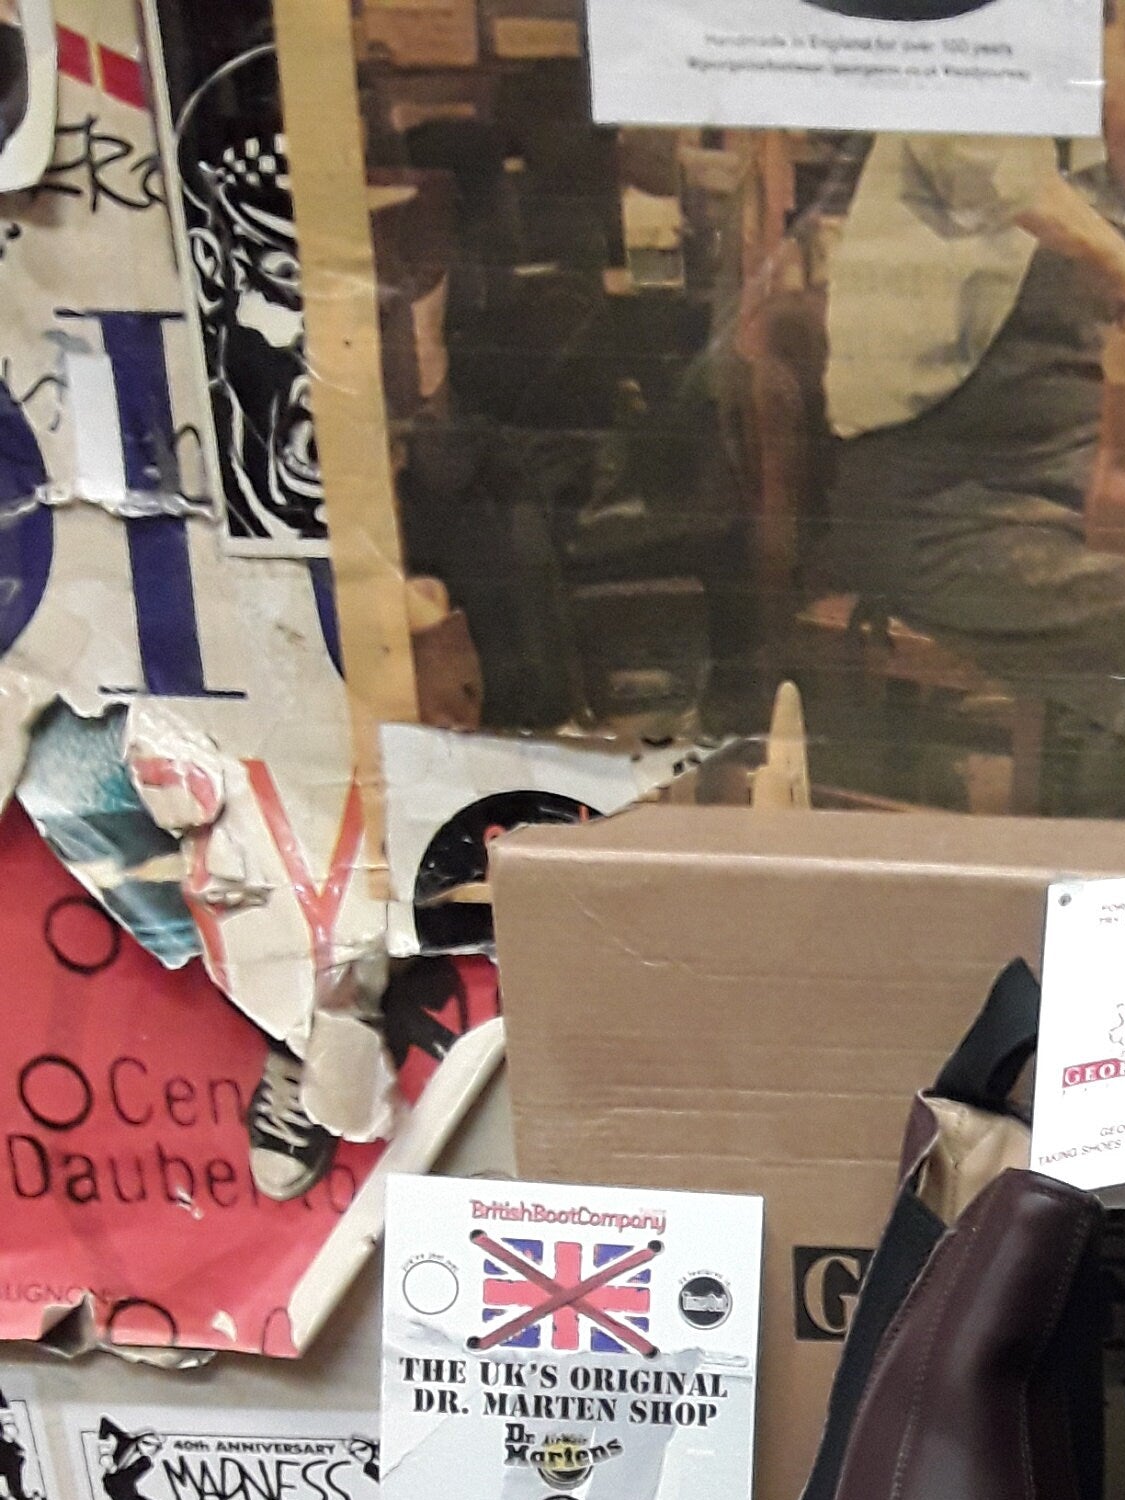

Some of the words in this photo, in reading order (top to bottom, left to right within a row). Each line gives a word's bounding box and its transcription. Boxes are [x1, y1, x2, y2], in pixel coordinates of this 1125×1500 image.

[400, 1356, 466, 1384] THE
[480, 1361, 558, 1390] UK'S
[570, 1365, 728, 1399] ORIGINAL
[413, 1388, 469, 1415] DR.
[482, 1392, 618, 1423] MARTEN
[629, 1401, 718, 1427] SHOP
[216, 1440, 336, 1455] ANNIVERSARY
